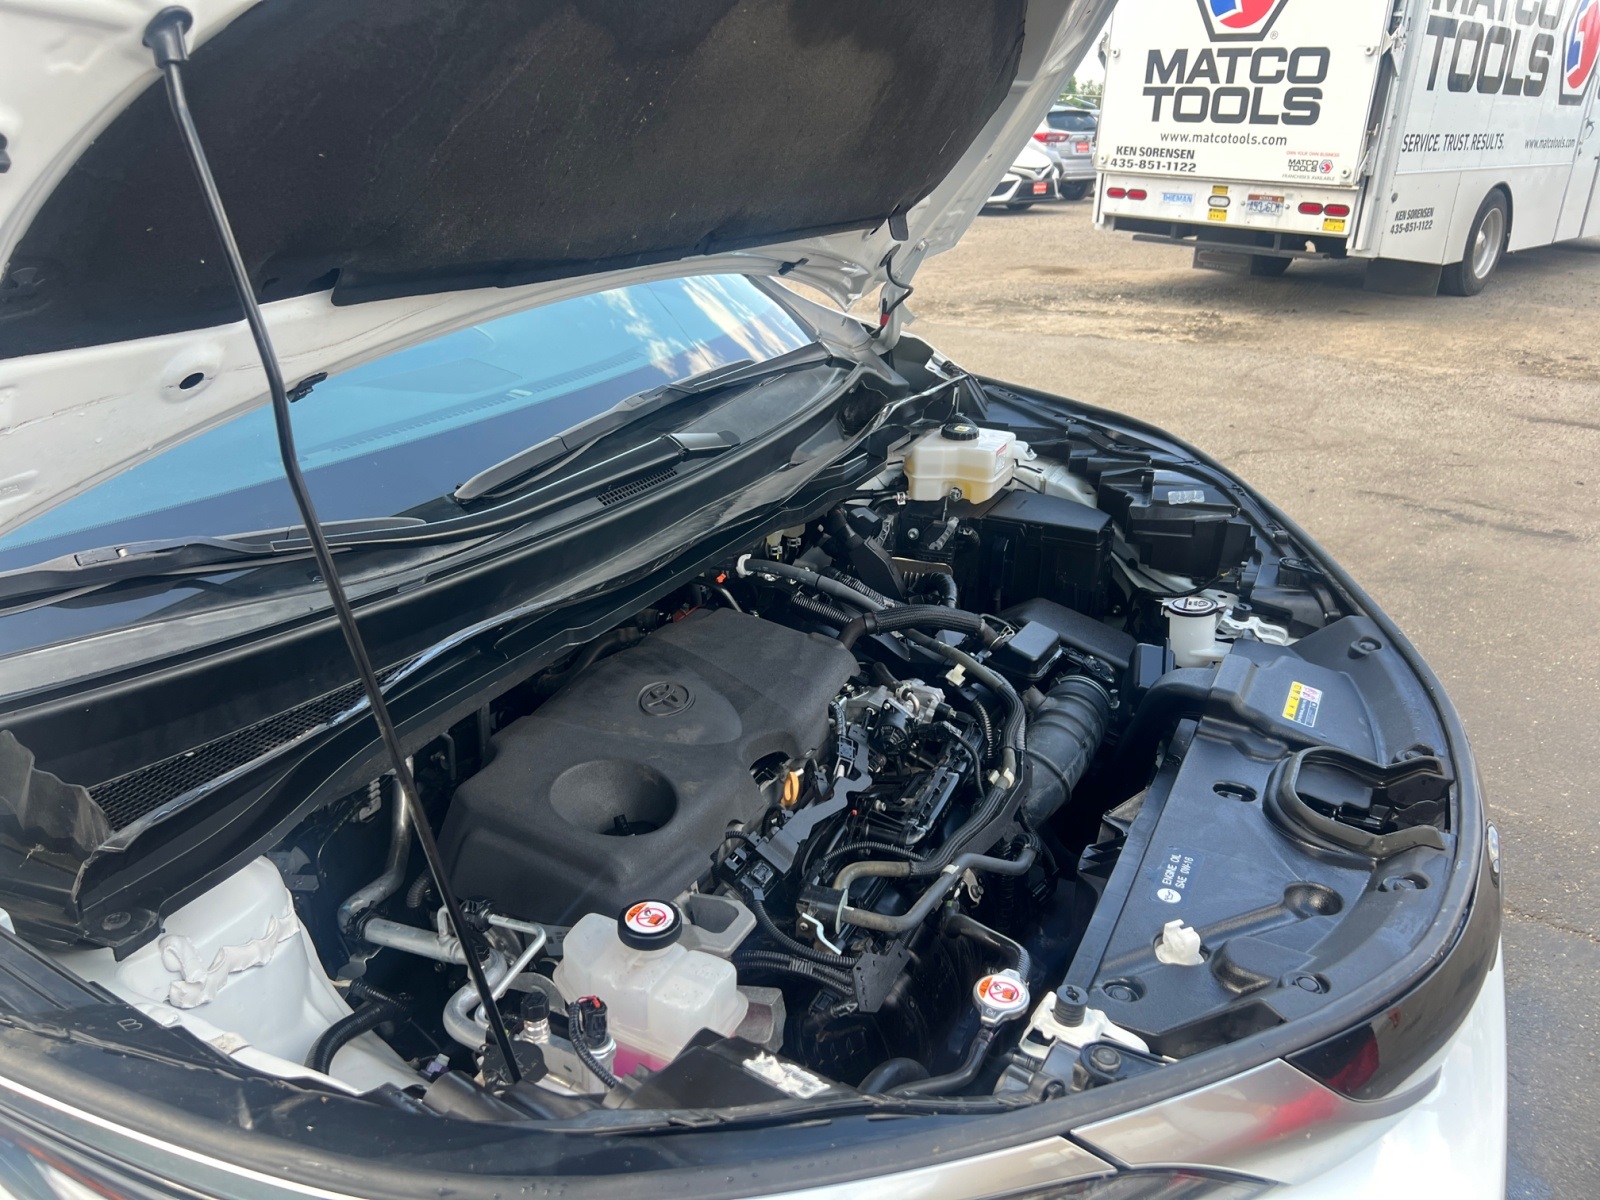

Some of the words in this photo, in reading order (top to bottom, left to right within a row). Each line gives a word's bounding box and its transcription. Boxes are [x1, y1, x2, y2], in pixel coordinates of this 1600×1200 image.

[1426, 15, 1554, 97] TOOLS
[1144, 47, 1331, 84] MATCO
[1142, 86, 1323, 126] TOOLS
[1160, 132, 1288, 147] www.matcotools.com
[1401, 134, 1440, 152] SERVICE.
[1443, 134, 1470, 151] TRUST.
[1470, 133, 1504, 150] RESULTS.
[1524, 137, 1576, 149] www.matcotools.com
[1116, 145, 1137, 156] KEN
[1138, 146, 1195, 160] SORENSEN
[1110, 157, 1197, 173] 435-851-1122
[1395, 210, 1407, 221] KEN
[1407, 207, 1434, 220] SORENSEN
[1390, 220, 1433, 234] 435-851-1122
[1161, 864, 1177, 885] ENGINE
[1170, 854, 1181, 863] OIL
[1174, 876, 1187, 889] SAE
